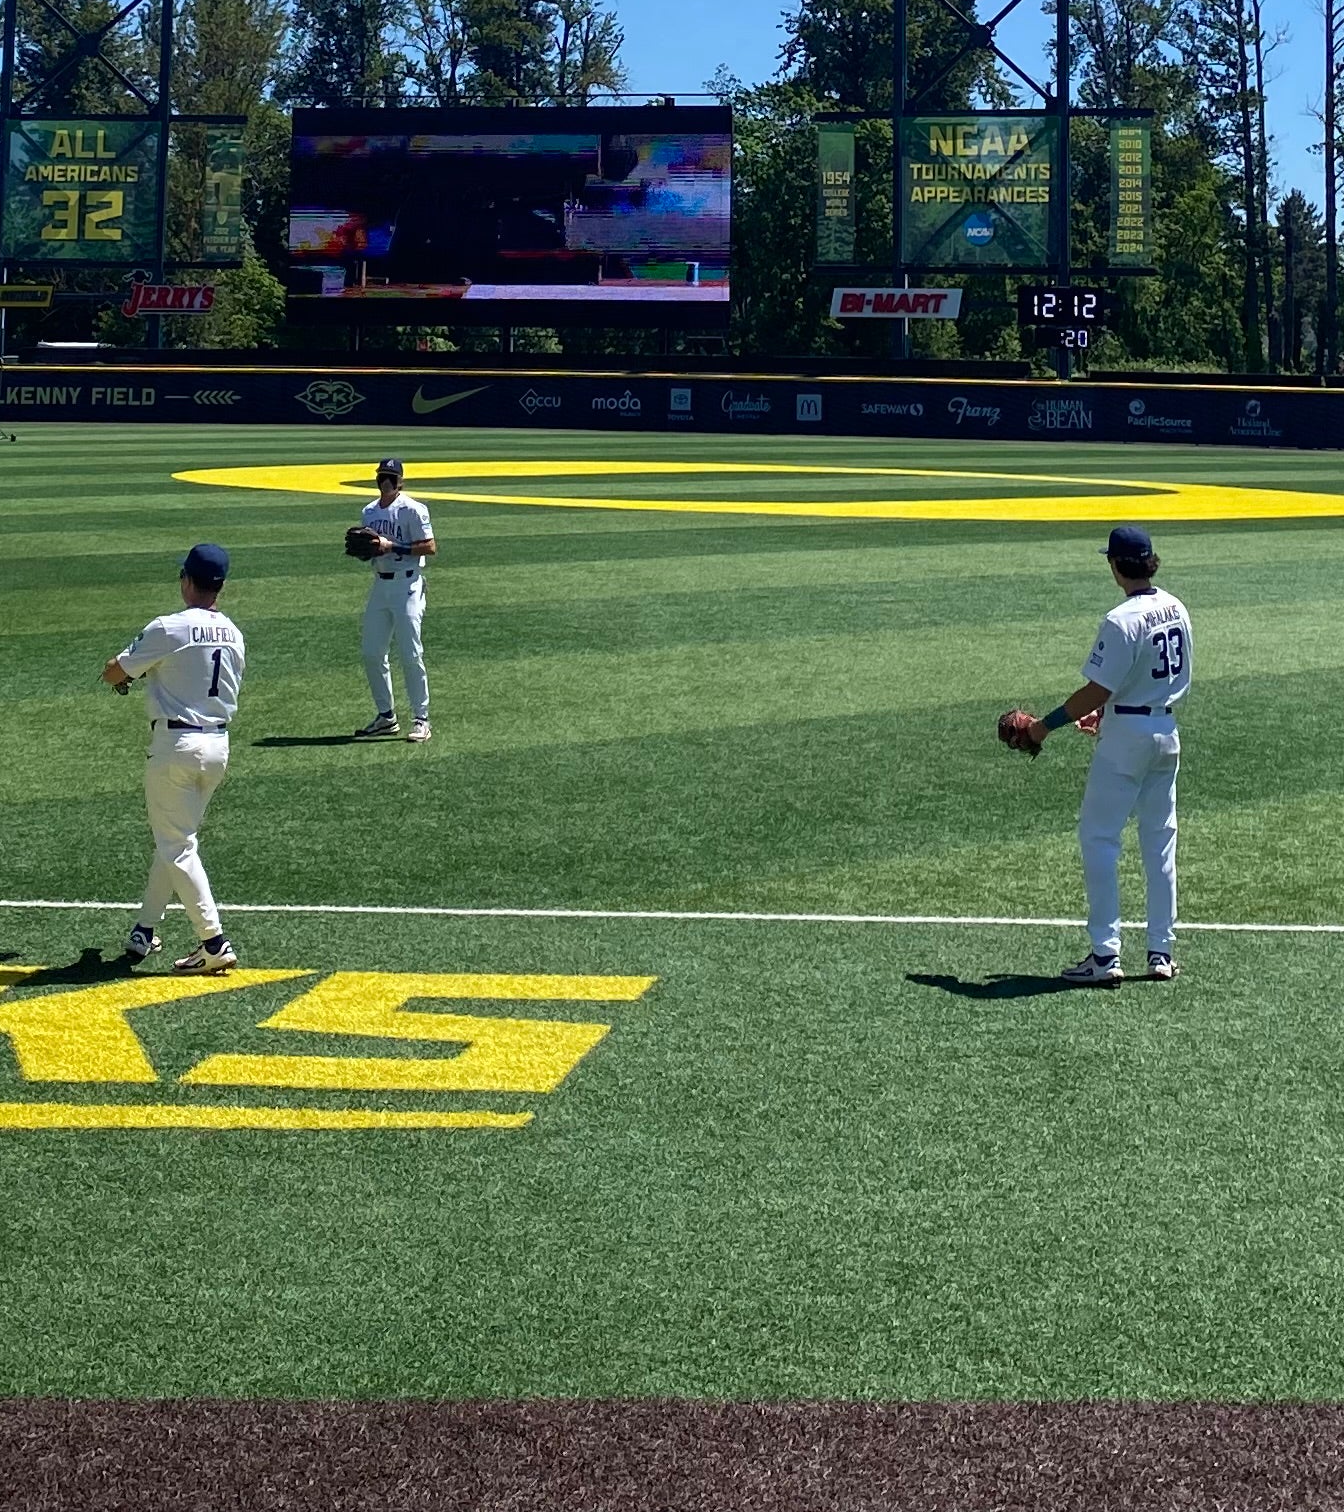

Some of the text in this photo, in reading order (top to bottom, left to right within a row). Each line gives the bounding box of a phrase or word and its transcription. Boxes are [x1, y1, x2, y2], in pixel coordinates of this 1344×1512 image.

[51, 130, 116, 158] ALL
[930, 125, 1031, 156] NCAA
[1119, 140, 1142, 148] 2010
[1119, 153, 1142, 162] 2012
[25, 165, 139, 182] AMERICANS
[910, 163, 1051, 180] TOURNAMENTS
[1119, 165, 1142, 175] 2013
[822, 171, 851, 185] 1954
[1119, 178, 1142, 188] 2014
[911, 186, 1050, 203] APPEARANCES
[1119, 191, 1142, 201] 2015
[41, 191, 124, 240] 32
[1119, 204, 1142, 213] 2021
[1117, 217, 1144, 226] 2022
[1117, 230, 1144, 240] 2023
[1117, 243, 1143, 253] 2024
[839, 293, 948, 314] BI-MART
[91, 387, 156, 406] FIELD
[315, 392, 347, 403] PK
[591, 389, 641, 410] moda
[861, 403, 909, 414] SAFEWAY
[948, 397, 1001, 426] Franz
[1046, 400, 1083, 410] HUMAN
[1046, 410, 1093, 428] BEAN
[1128, 416, 1192, 428] PacificSource
[1151, 627, 1183, 679] 33
[208, 648, 222, 697] 1
